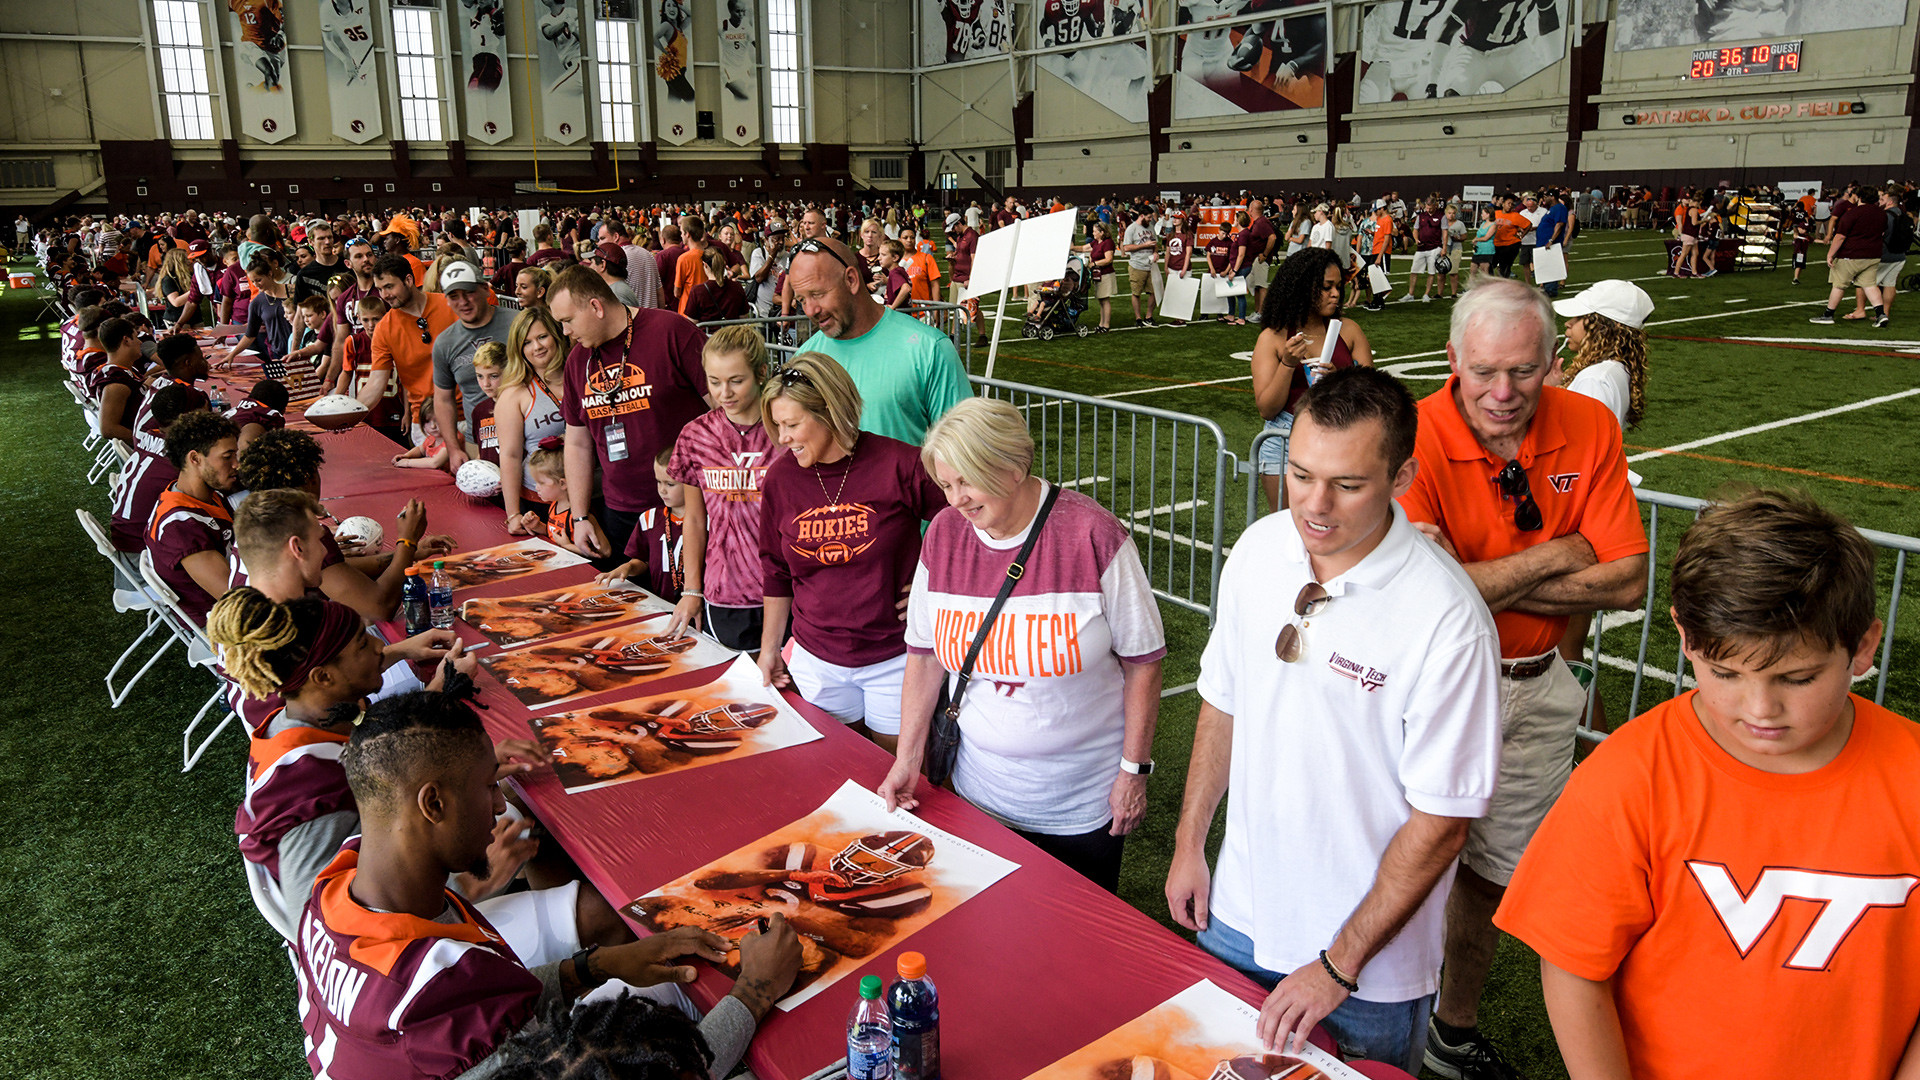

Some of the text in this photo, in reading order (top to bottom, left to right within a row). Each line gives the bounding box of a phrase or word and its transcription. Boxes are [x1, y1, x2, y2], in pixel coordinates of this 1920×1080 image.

[244, 13, 257, 25] 12
[343, 25, 368, 42] 35
[953, 21, 972, 54] 78
[1058, 16, 1081, 42] 58
[733, 42, 740, 50] 5
[1693, 51, 1718, 61] HOME
[1770, 43, 1799, 55] GUEST
[1691, 53, 1797, 78] 20 QTR 19
[1637, 101, 1852, 126] PATRICK D. CUPP FIELD
[446, 268, 466, 279] VT
[629, 384, 653, 399] OUT
[731, 452, 763, 468] VT
[112, 450, 154, 520] 81
[703, 469, 758, 491] VIRGINIA
[1547, 473, 1581, 493] VT
[799, 513, 869, 540] HOKIES
[796, 531, 870, 544] FOOTBALL
[825, 551, 843, 562] VT
[935, 608, 1082, 677] VIRGINIA TECH
[1361, 678, 1384, 692] VT
[1684, 859, 1920, 971] VT
[1320, 1058, 1347, 1077] TECH
